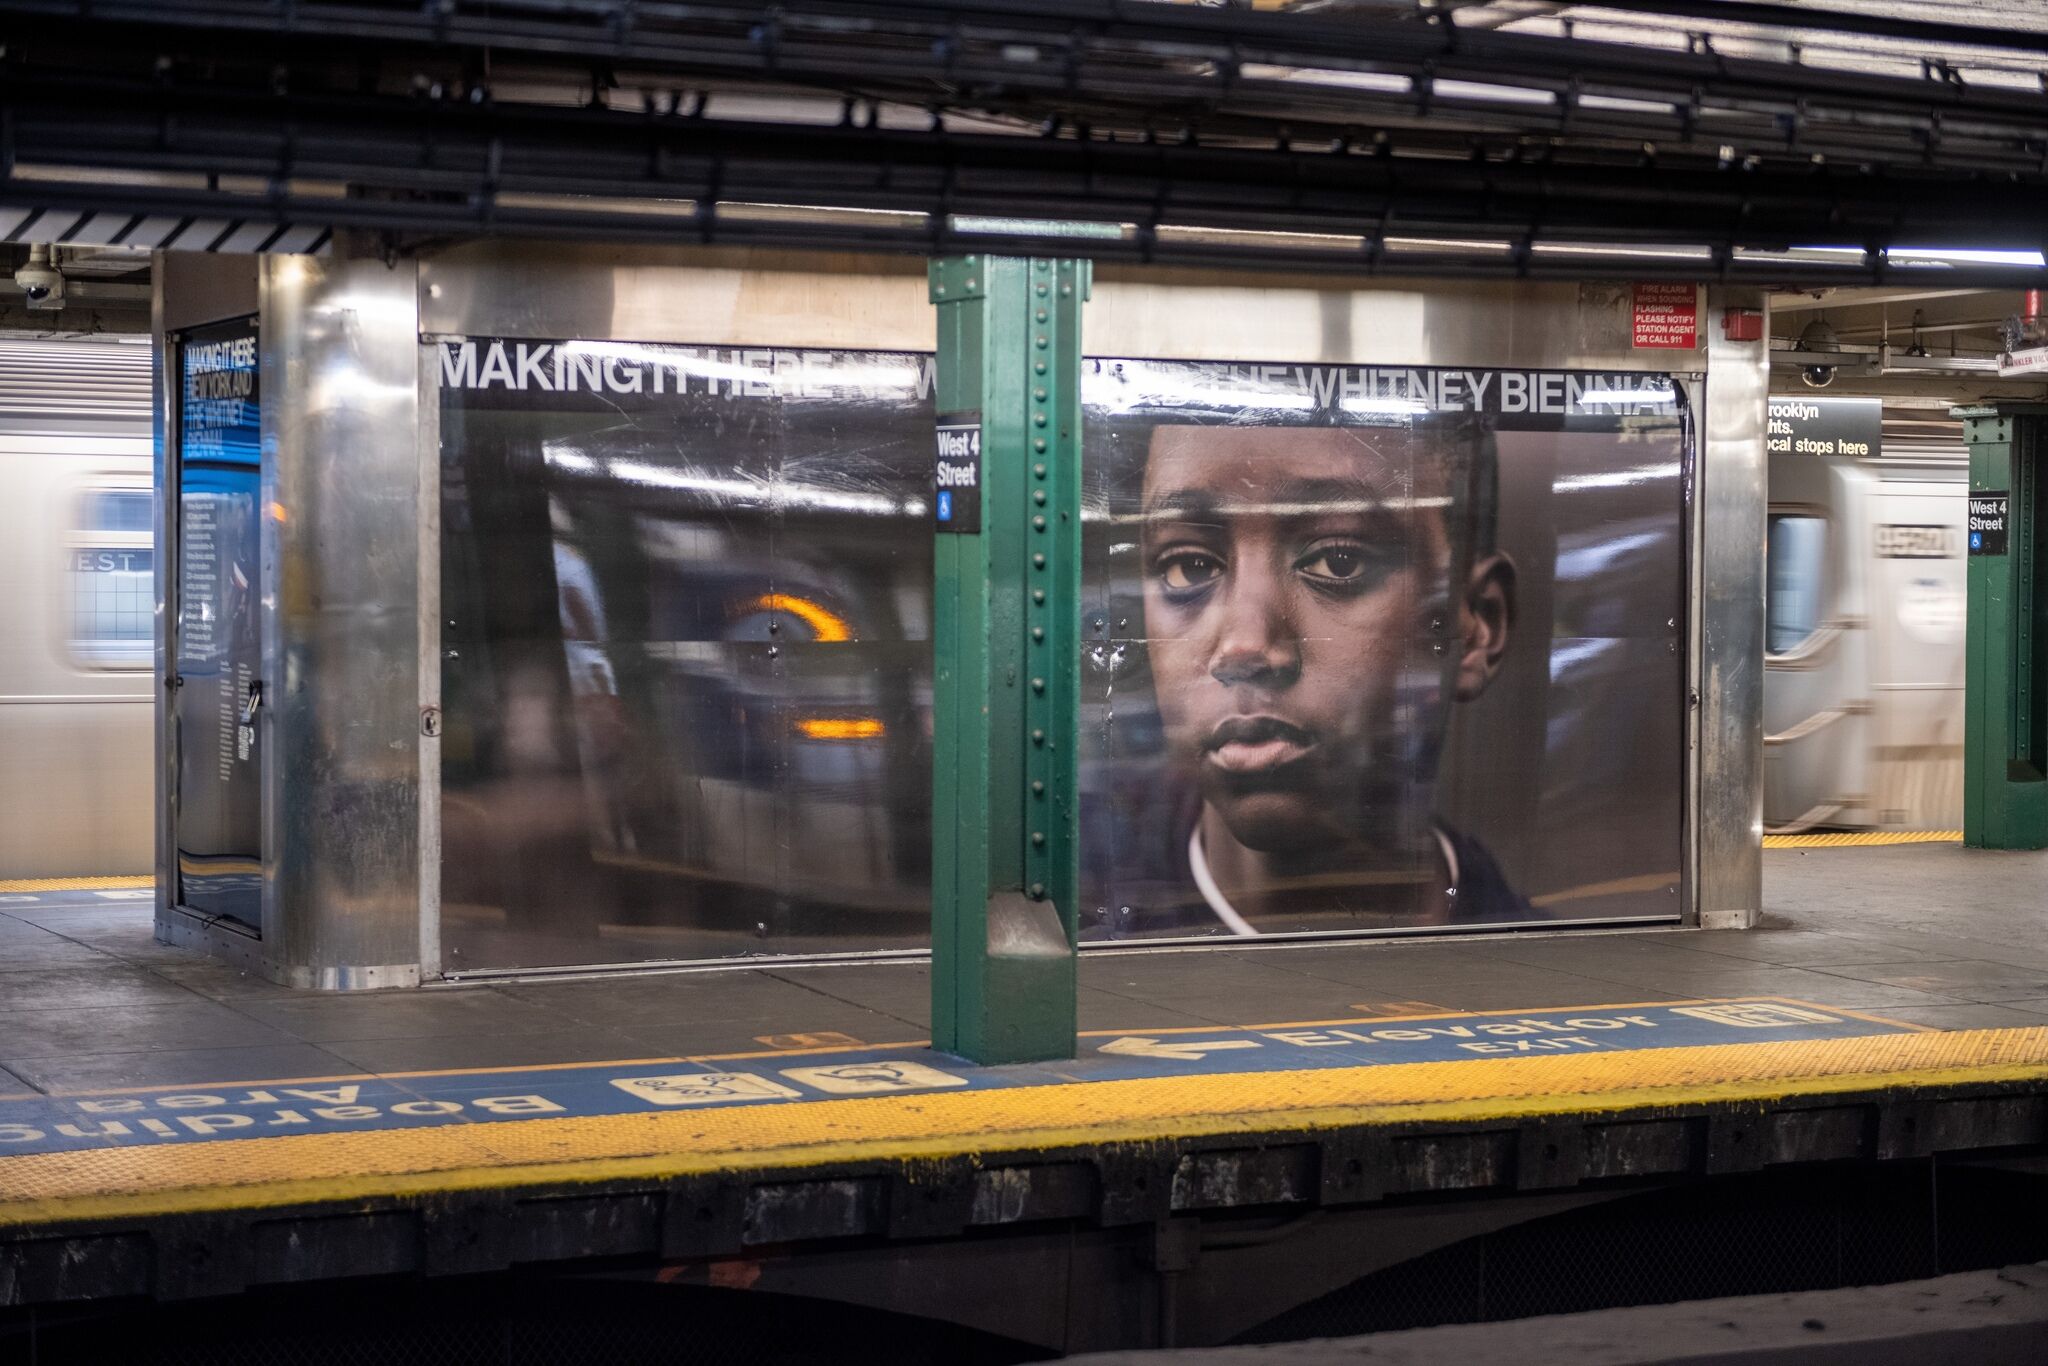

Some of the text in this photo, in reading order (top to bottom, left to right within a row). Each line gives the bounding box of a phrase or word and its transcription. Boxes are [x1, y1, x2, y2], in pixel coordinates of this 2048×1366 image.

[1642, 285, 1687, 294] FIRE ALARM
[1636, 305, 1674, 313] FLASHING
[1636, 315, 1694, 324] PLEASE NOTIFY
[1636, 325, 1694, 334] STATION AGENT
[1636, 335, 1682, 344] OR CALL 911
[232, 369, 252, 397] AND
[439, 342, 643, 394] MAKING
[1295, 366, 1492, 412] WHITNEY
[1768, 403, 1819, 420] rooklyn
[1767, 419, 1794, 435] hts.
[938, 430, 980, 457] West 4
[1795, 438, 1834, 455] stops
[1838, 439, 1869, 455] here
[937, 461, 976, 487] Street
[1970, 501, 2007, 514] West 4
[1970, 517, 2003, 530] Street
[1263, 1015, 1659, 1047] Elevator
[1456, 1036, 1599, 1053] EXIT
[76, 1085, 360, 1112] Area
